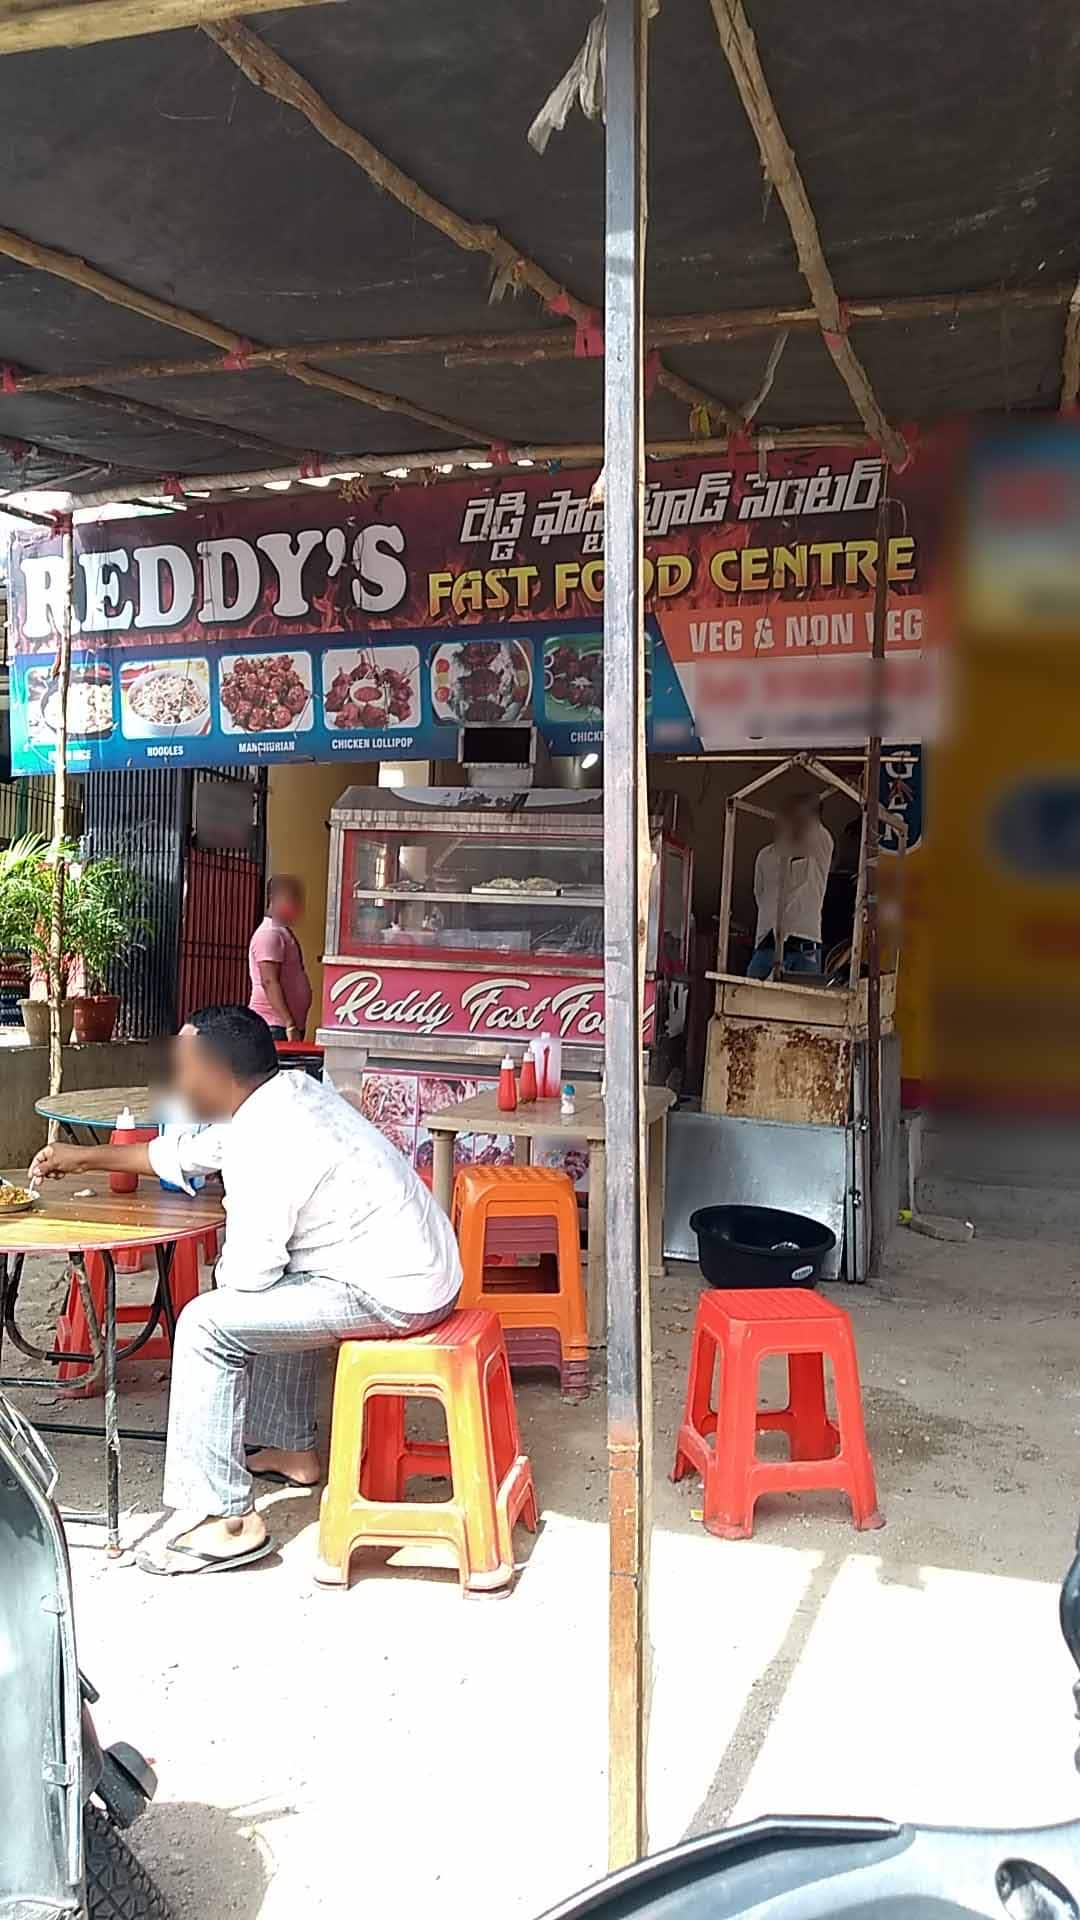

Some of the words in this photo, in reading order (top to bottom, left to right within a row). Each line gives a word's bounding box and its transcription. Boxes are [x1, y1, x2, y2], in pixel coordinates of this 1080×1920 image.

[21, 524, 408, 639] REDDY'S
[428, 566, 538, 617] FAST
[555, 555, 693, 609] FOD
[710, 537, 916, 592] CENTRE
[689, 620, 742, 653] VEG
[754, 618, 775, 649] &
[786, 613, 853, 648] NON
[147, 745, 184, 757] NOODLES
[238, 741, 295, 753] MANCHURIAN
[331, 738, 370, 750] CHICKEN
[372, 737, 413, 749] LOLLIPOP
[330, 970, 453, 1034] Reddy
[461, 978, 551, 1032] Fast
